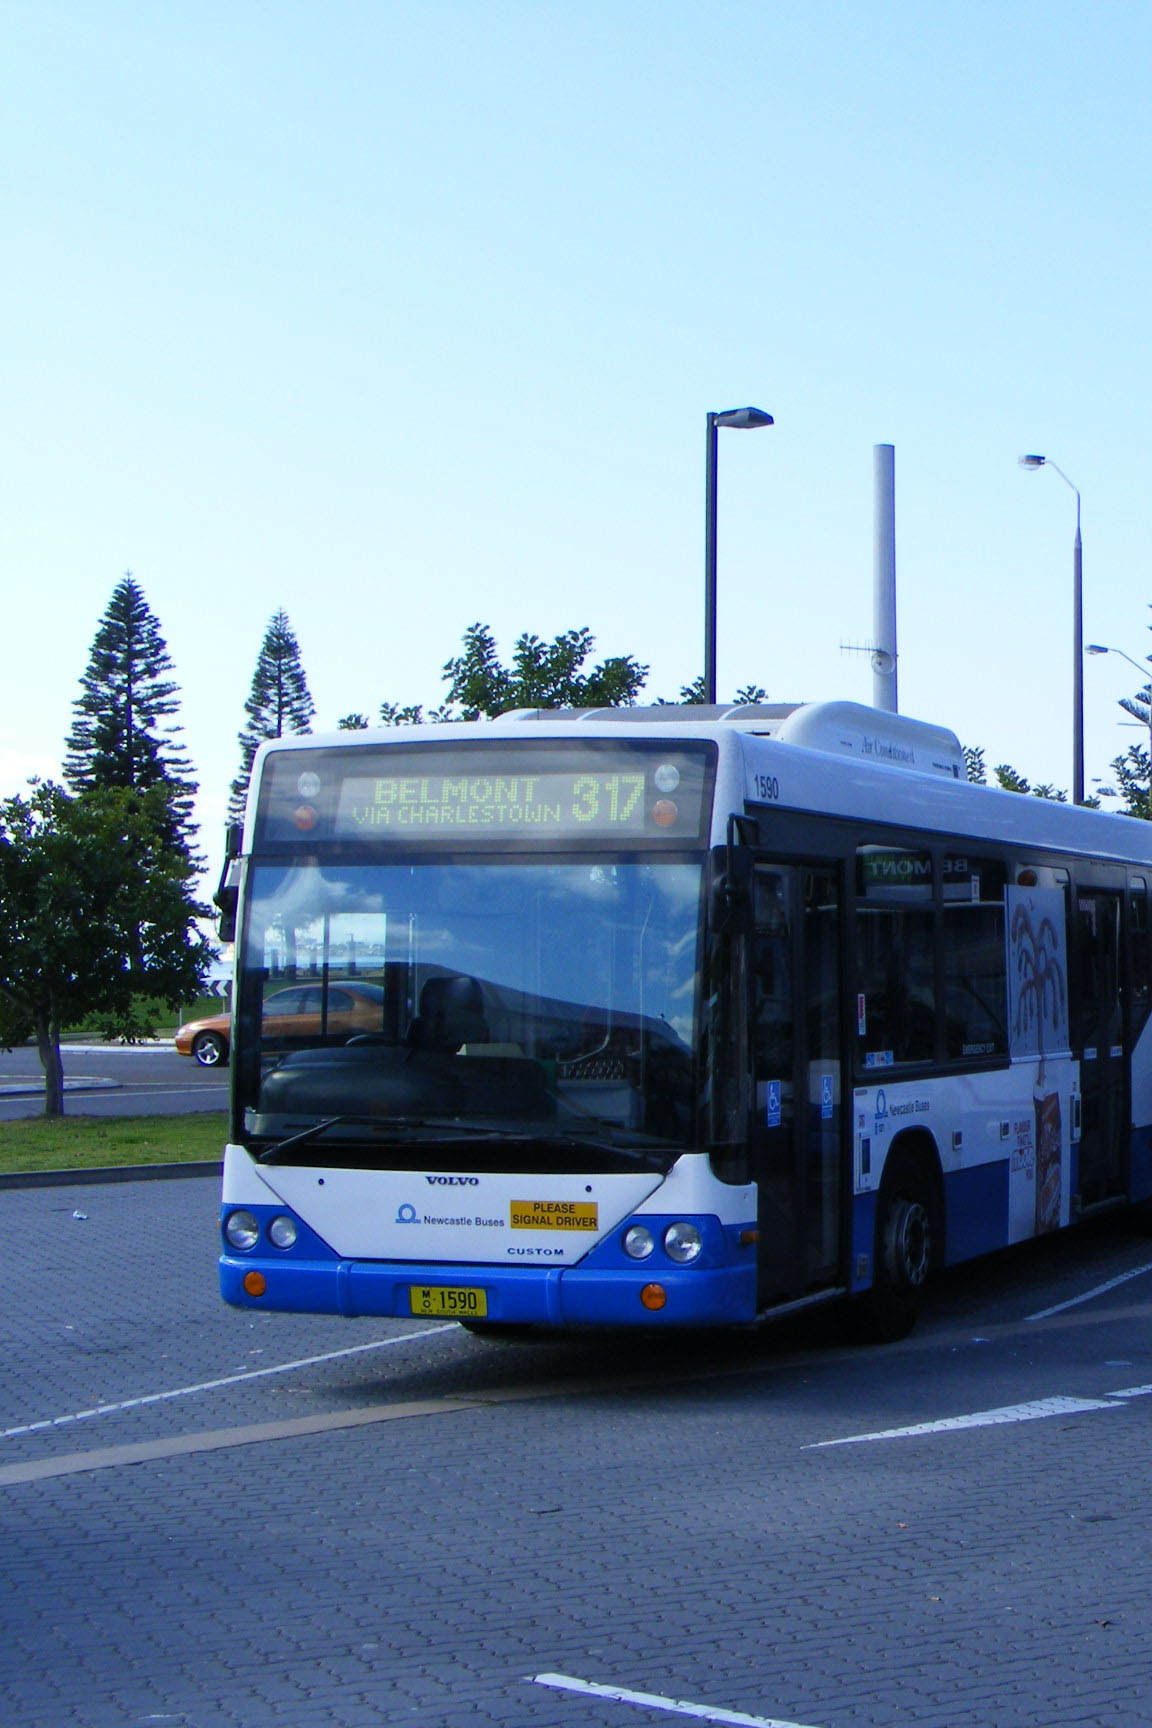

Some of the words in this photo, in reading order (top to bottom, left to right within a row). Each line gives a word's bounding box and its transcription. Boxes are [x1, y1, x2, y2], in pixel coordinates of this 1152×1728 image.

[754, 774, 779, 799] 1590
[374, 777, 540, 804] BELMONT
[571, 775, 645, 822] 317
[352, 805, 390, 824] VIA
[399, 803, 561, 824] CHARLESTOWN
[425, 1176, 479, 1186] VOLVO
[533, 1203, 576, 1214] PLEASE
[423, 1216, 472, 1226] Newcastle
[475, 1216, 505, 1227] Buses
[512, 1215, 552, 1226] SIGNAL
[556, 1216, 597, 1227] DRIVER
[507, 1247, 564, 1256] CUSTOM
[439, 1291, 477, 1310] 1590
